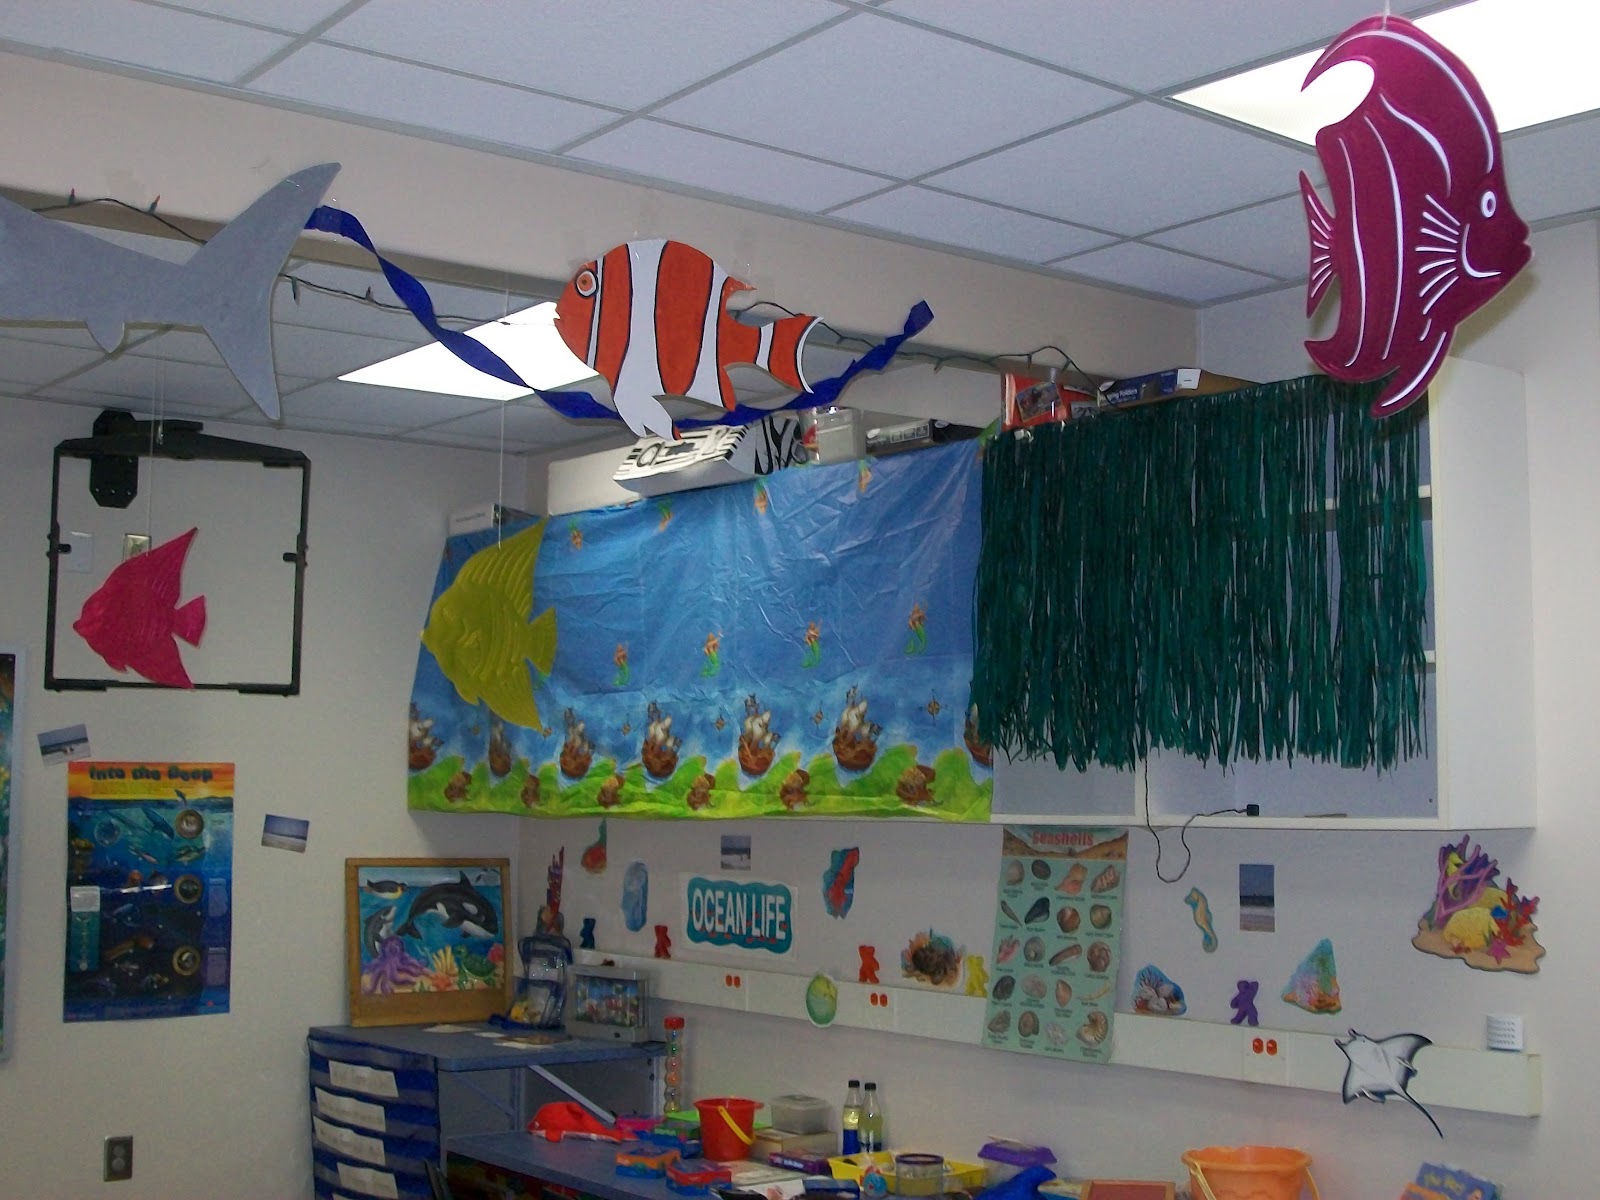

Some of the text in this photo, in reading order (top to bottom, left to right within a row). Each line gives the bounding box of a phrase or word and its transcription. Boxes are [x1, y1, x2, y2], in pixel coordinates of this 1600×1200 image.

[89, 765, 213, 783] Into the Deep
[1032, 830, 1094, 847] Seashells
[692, 888, 787, 941] OCEAN LIFE
